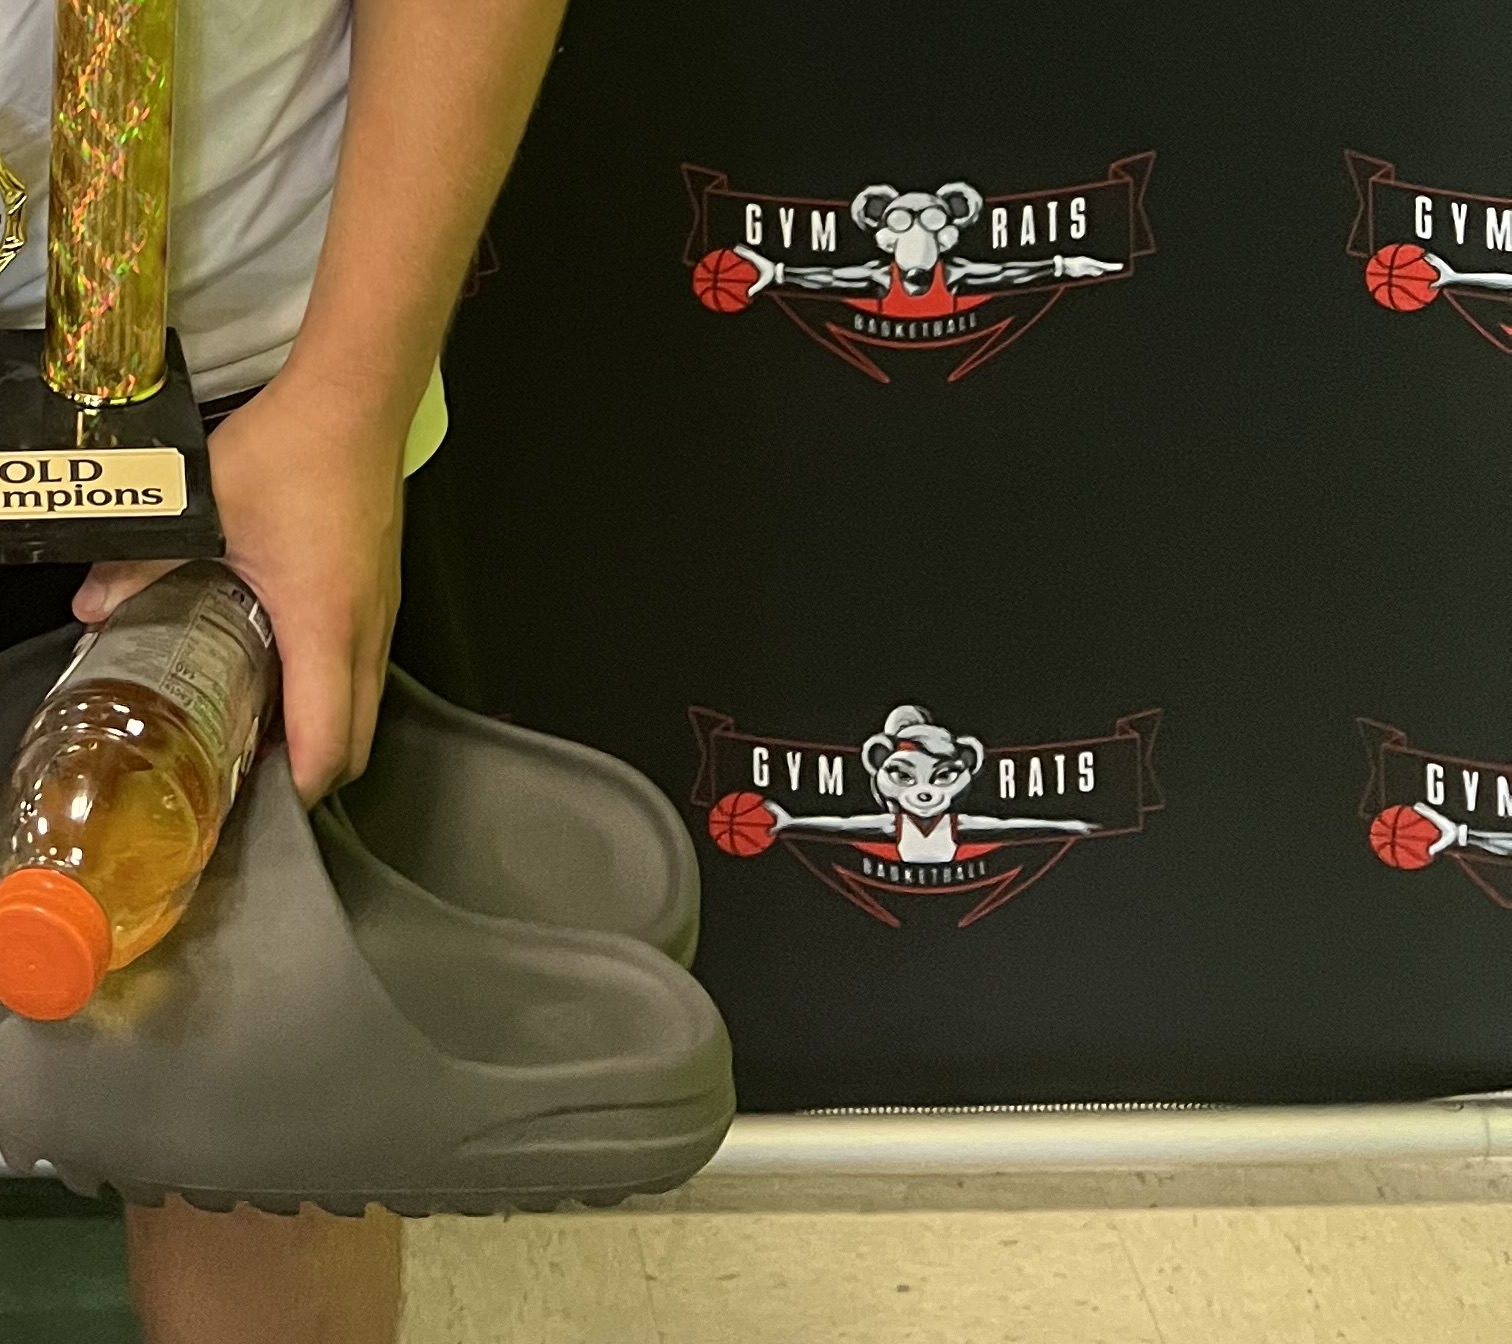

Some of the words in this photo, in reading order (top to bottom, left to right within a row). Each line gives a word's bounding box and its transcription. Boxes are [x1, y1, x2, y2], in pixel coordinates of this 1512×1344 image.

[746, 204, 835, 251] GYM
[992, 197, 1085, 249] RATS
[1416, 196, 1512, 251] GYM
[753, 747, 843, 795] GYM
[1000, 752, 1094, 798] RATS
